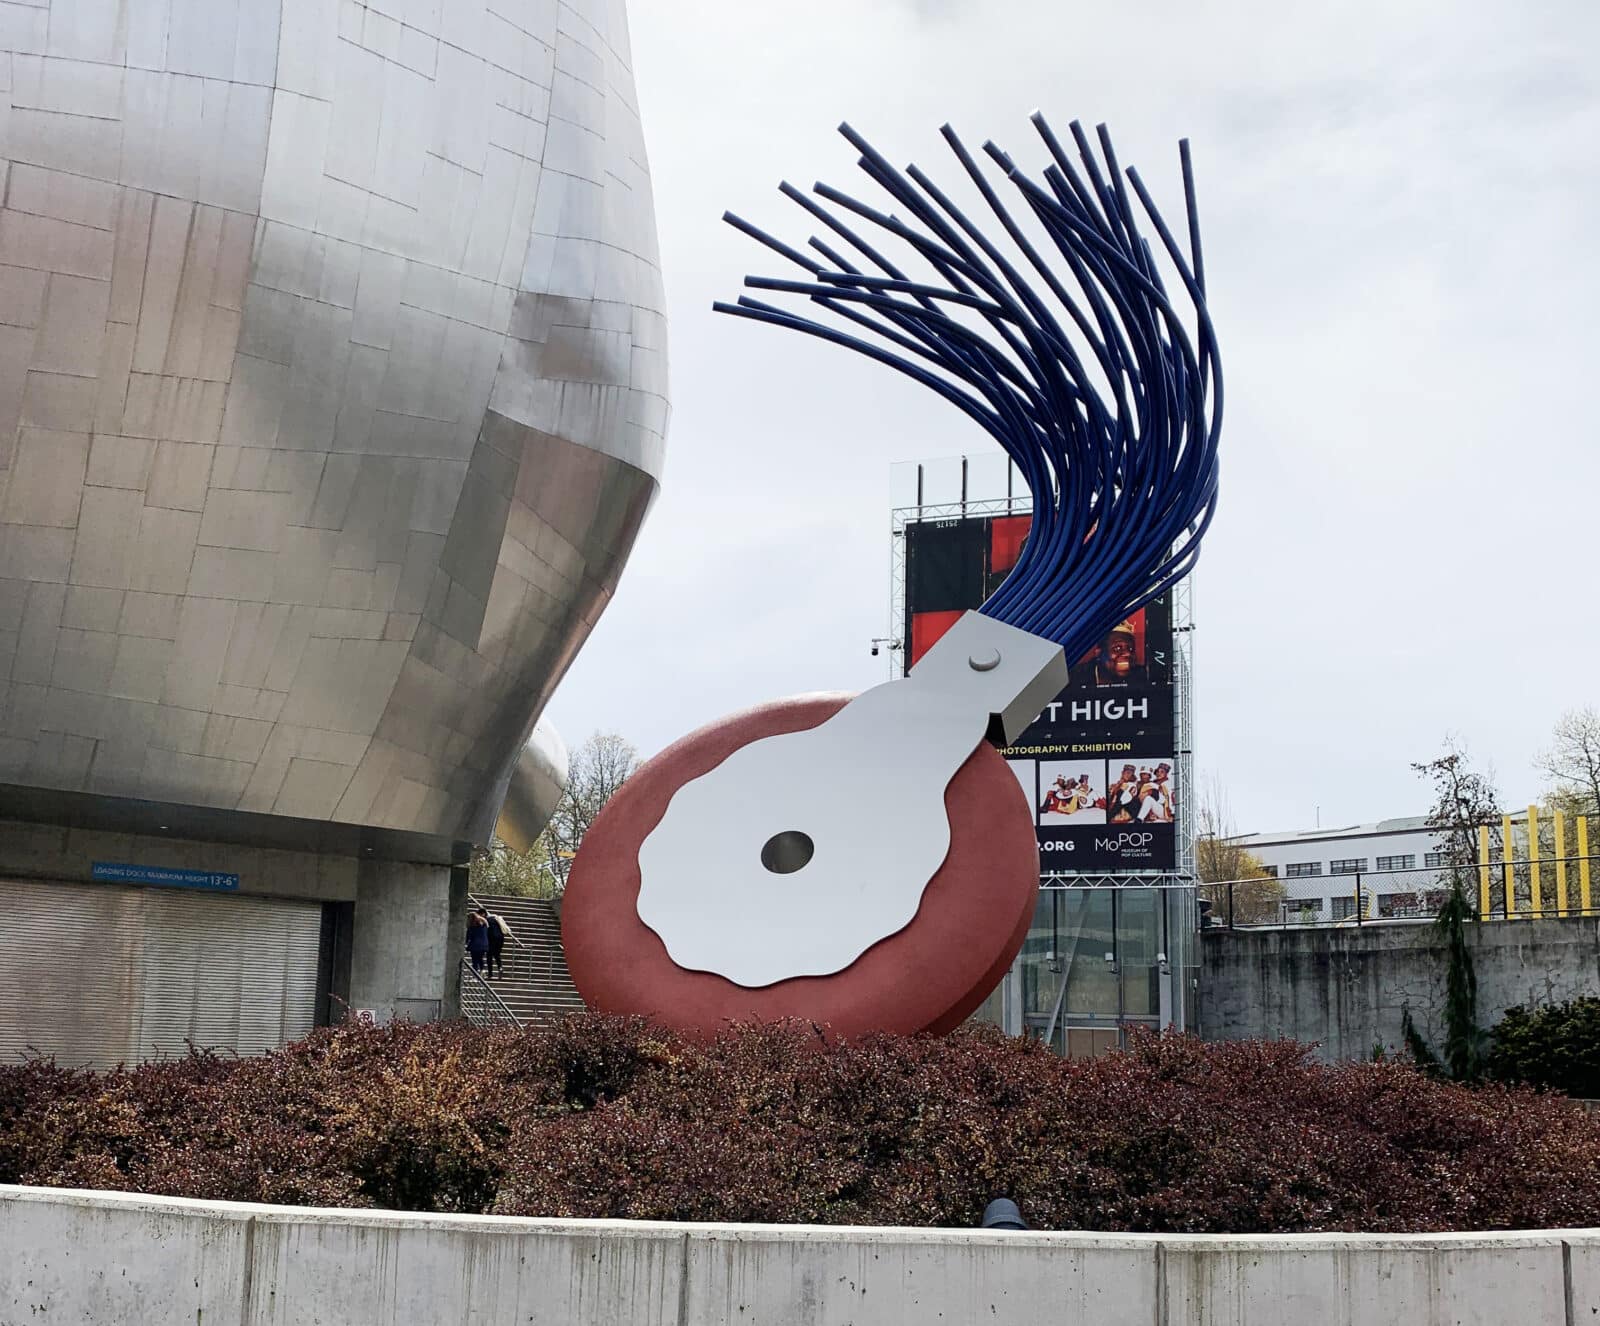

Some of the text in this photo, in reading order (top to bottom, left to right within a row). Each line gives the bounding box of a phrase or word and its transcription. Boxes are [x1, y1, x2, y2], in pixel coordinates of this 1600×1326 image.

[1071, 697, 1148, 722] HIGH
[996, 742, 1131, 756] HOTOGRAPHY EXHIBITION
[1095, 832, 1153, 852] MoPOP
